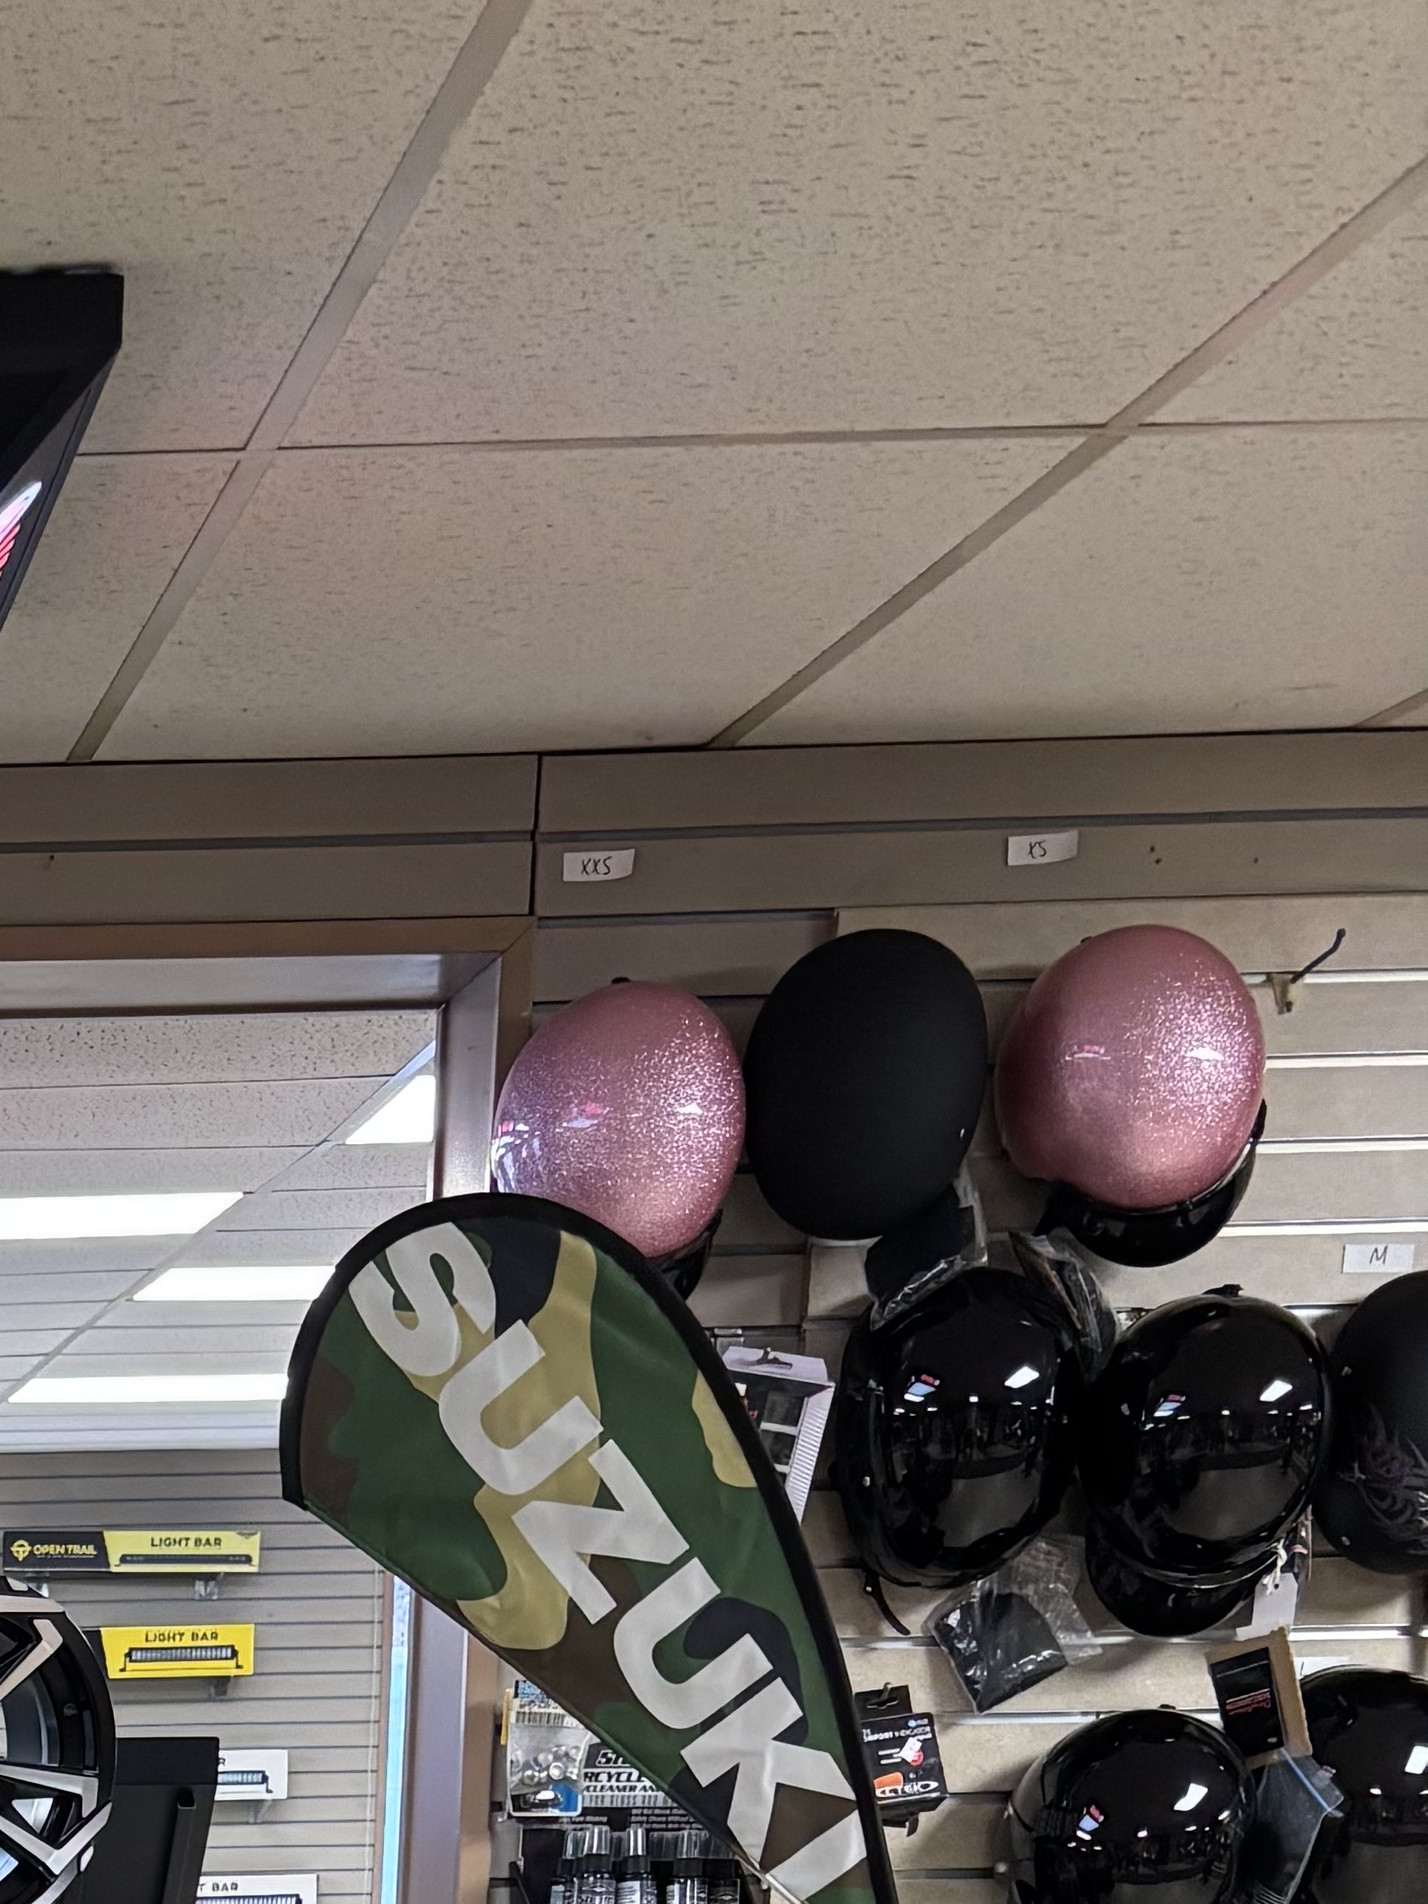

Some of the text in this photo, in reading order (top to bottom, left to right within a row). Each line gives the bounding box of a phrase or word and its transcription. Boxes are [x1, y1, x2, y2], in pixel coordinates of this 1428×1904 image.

[580, 857, 613, 876] XXS
[1369, 1247, 1388, 1265] M
[151, 1537, 222, 1549] LIGHT BAR
[348, 1221, 867, 1902] SUZUKI
[145, 1631, 219, 1643] LIGHT BAR
[212, 1882, 238, 1892] BAR
